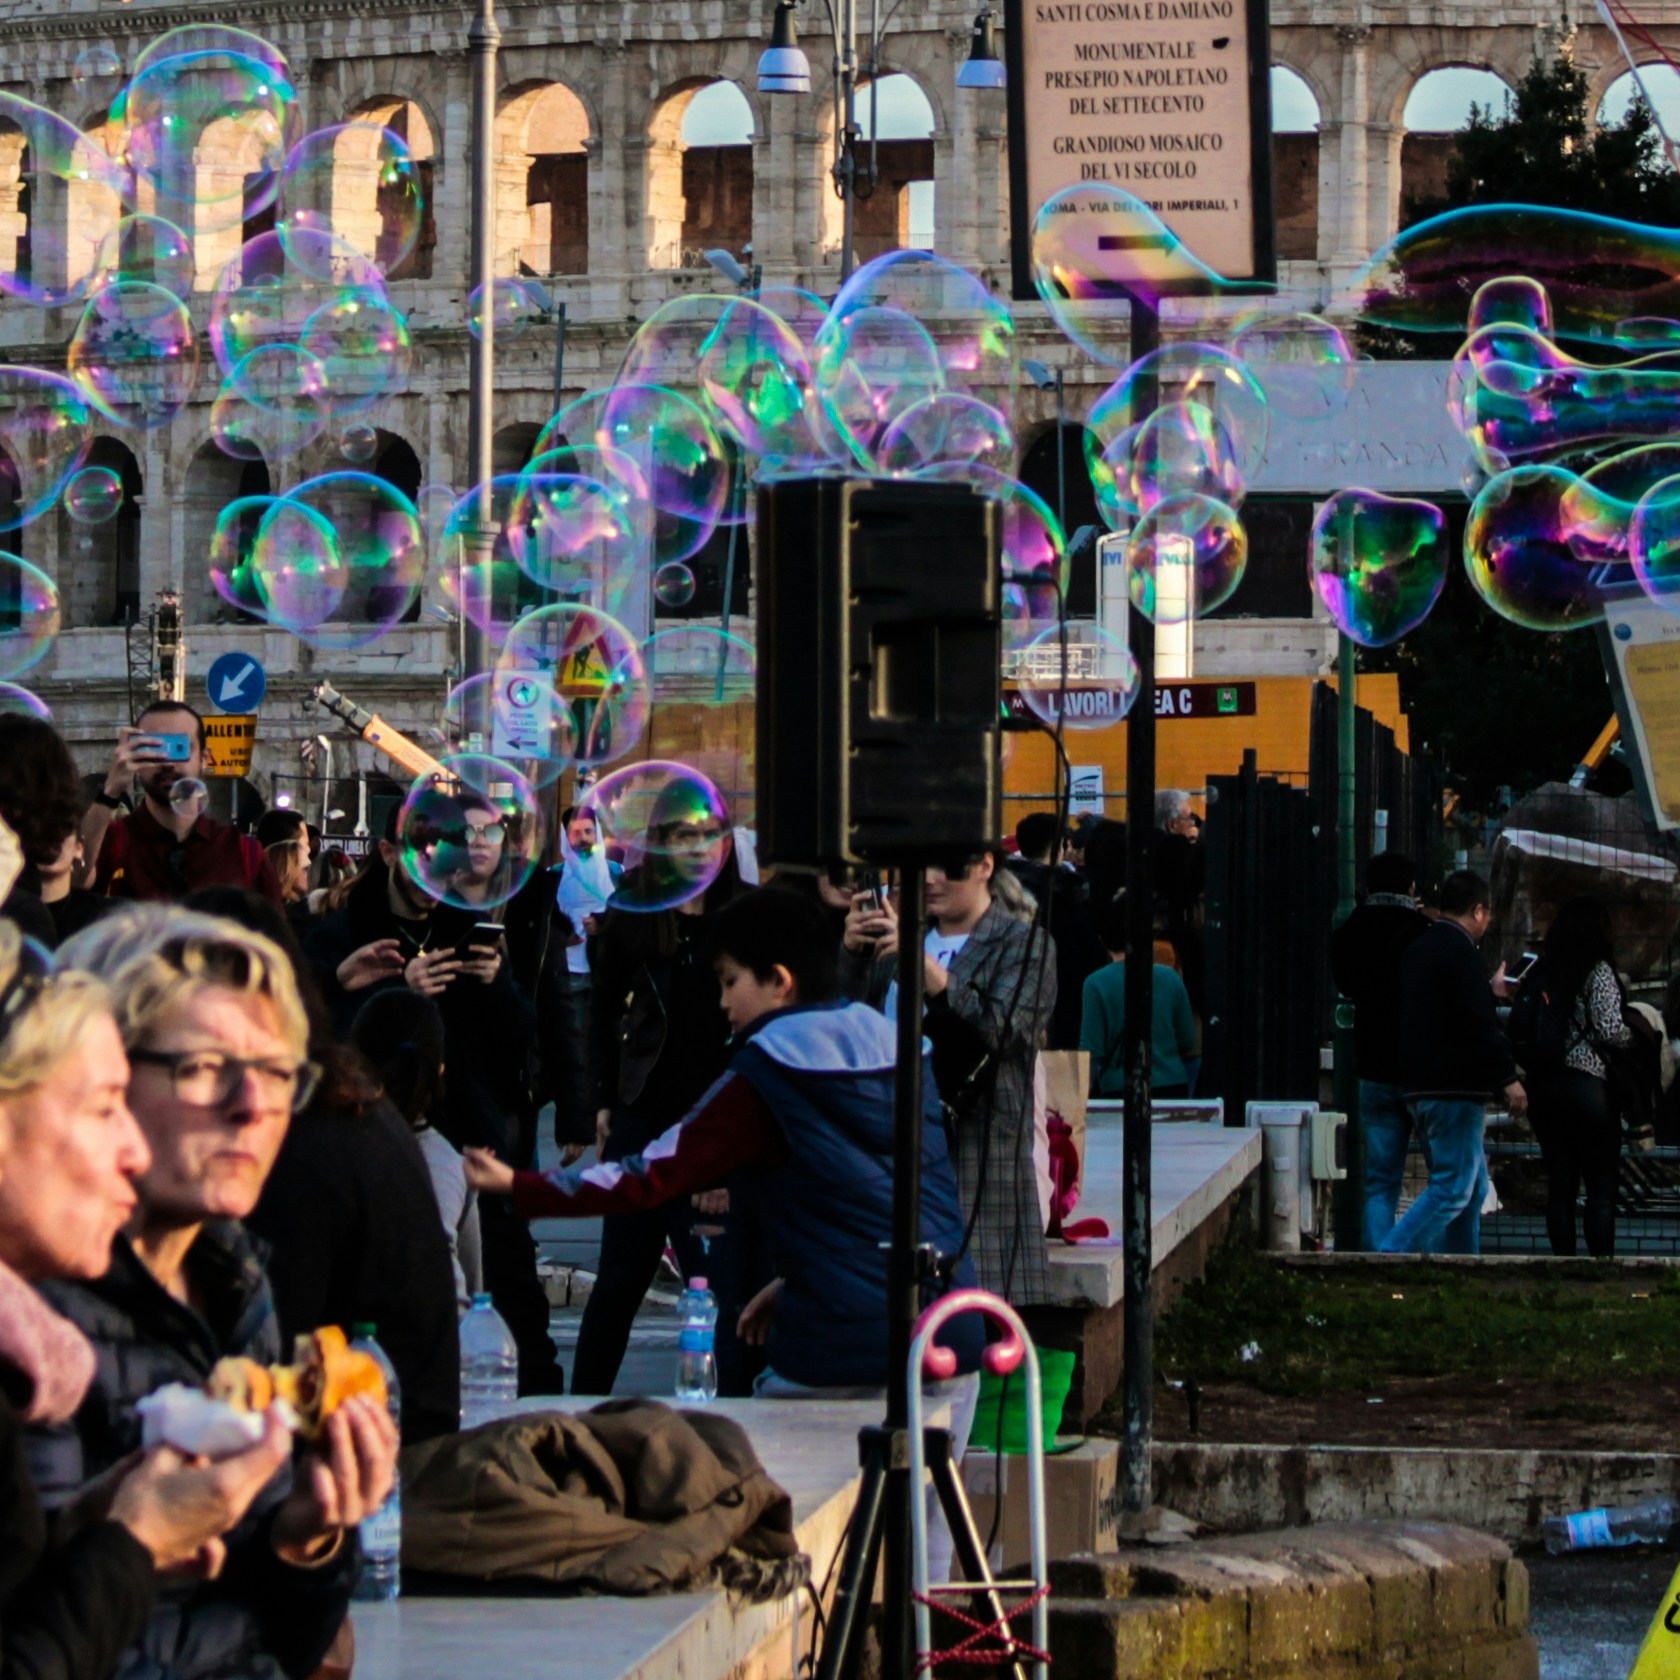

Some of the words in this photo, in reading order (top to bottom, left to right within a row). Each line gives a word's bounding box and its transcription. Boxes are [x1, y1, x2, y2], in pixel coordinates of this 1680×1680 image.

[1036, 4, 1081, 22] SANTI
[1085, 3, 1140, 21] COSMA
[1145, 2, 1154, 19] E
[1158, 0, 1233, 19] DAMIANO
[1074, 41, 1196, 61] MONUMENTALE
[1045, 70, 1119, 89] PRESEPIO
[1123, 67, 1228, 87] NAPOLETANO
[1069, 97, 1100, 115] DEL
[1103, 94, 1204, 114] SETTECENTO
[1053, 135, 1145, 154] GRANDIOSO
[1149, 133, 1223, 152] MOSAICO
[1081, 163, 1111, 180] DEL
[1114, 162, 1130, 179] VI
[1134, 161, 1197, 179] SECOLO
[1041, 202, 1077, 214] OMA
[1089, 202, 1109, 213] VIA
[1136, 200, 1163, 212] ORI
[1167, 199, 1229, 212] IMPERIALI,
[1233, 199, 1239, 209] 1
[1048, 691, 1111, 716] LAVORI
[1120, 689, 1175, 715] LEA
[1179, 688, 1192, 714] C
